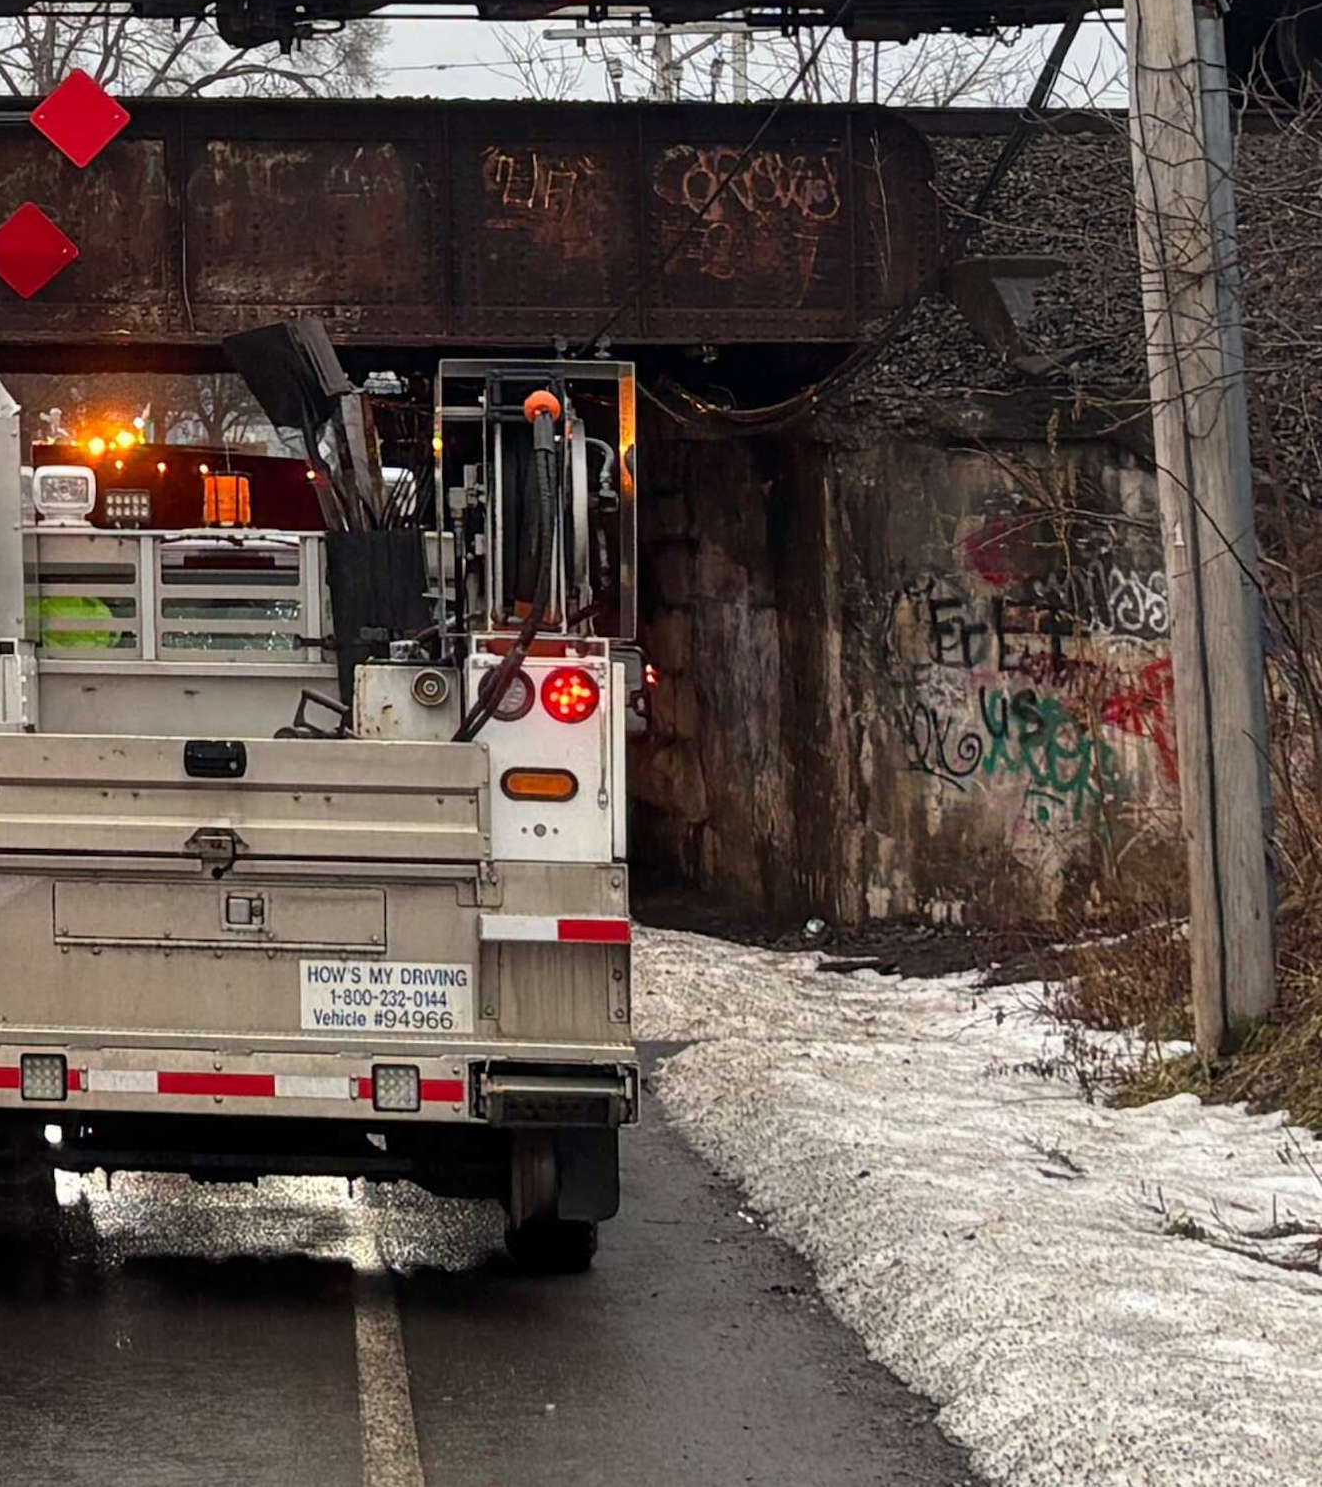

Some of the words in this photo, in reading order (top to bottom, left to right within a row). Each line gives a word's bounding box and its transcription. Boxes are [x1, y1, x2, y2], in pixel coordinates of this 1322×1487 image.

[307, 966, 362, 984] HOW'S
[369, 967, 393, 984] MY
[401, 968, 468, 987] DRIVING
[331, 989, 447, 1008] 1-800-232-0144
[313, 1009, 366, 1026] Vehicle
[374, 1009, 454, 1030] #94966
